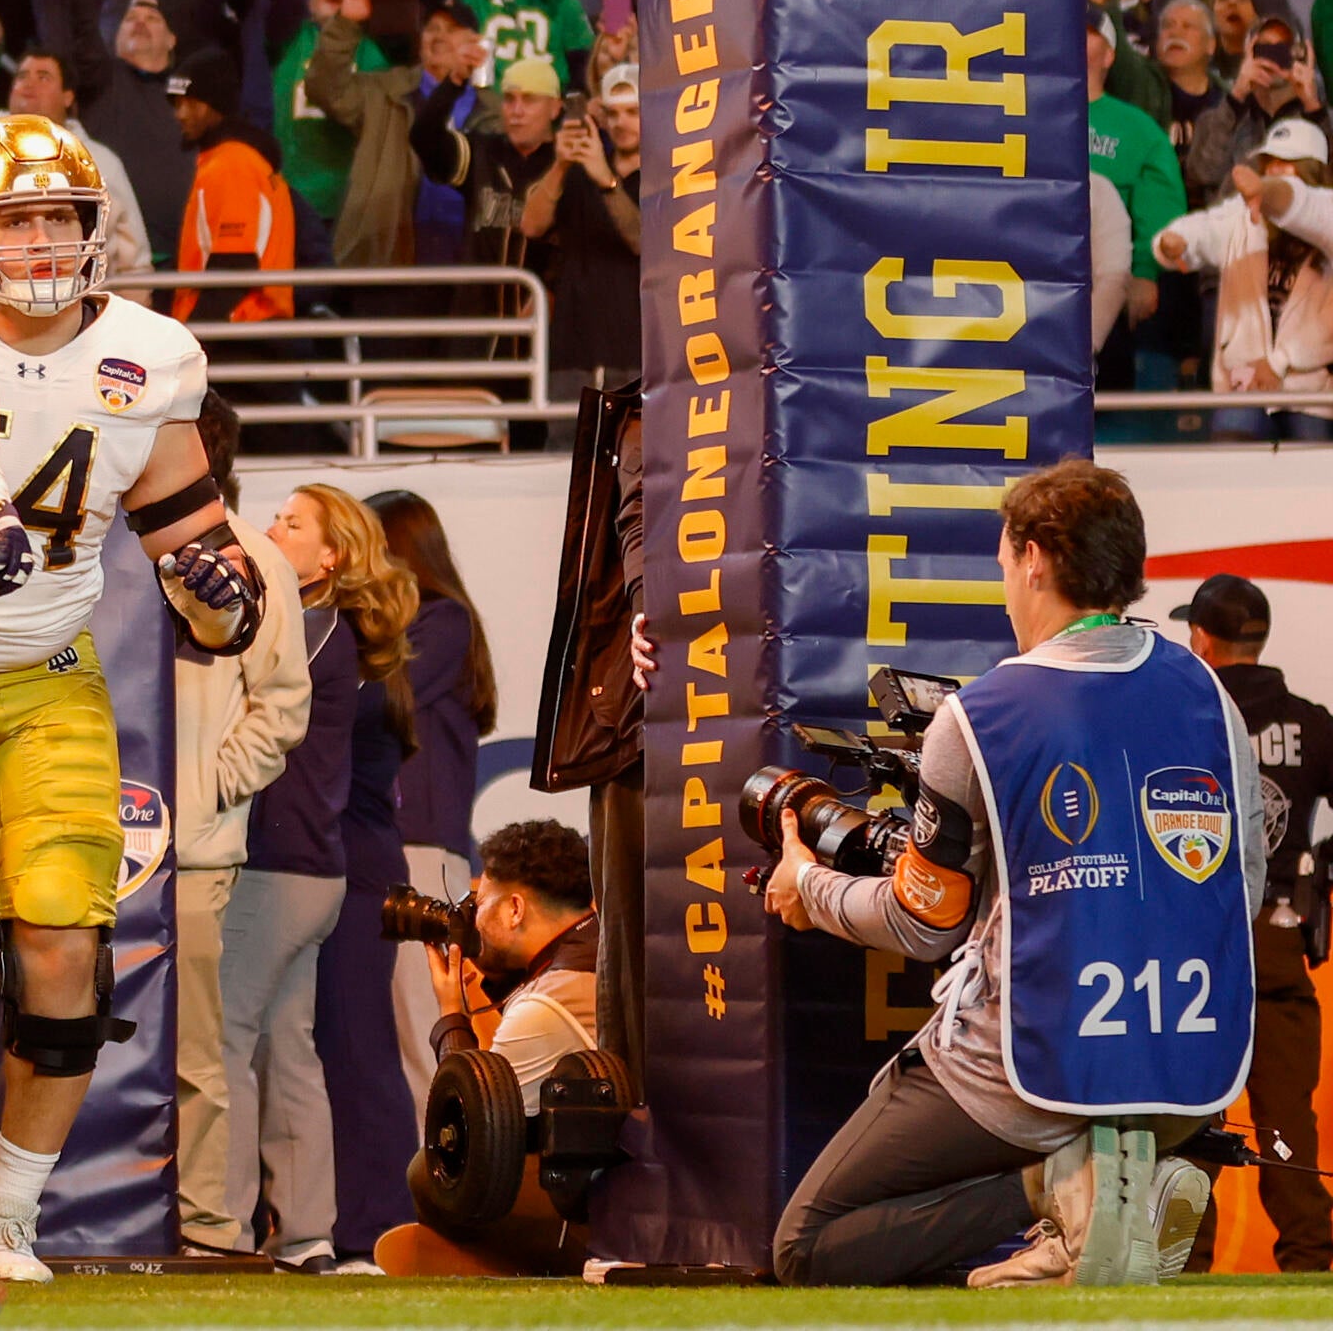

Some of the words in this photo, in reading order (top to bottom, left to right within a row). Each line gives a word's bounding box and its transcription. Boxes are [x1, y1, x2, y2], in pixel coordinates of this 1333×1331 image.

[1150, 788, 1223, 805] CapitalOne
[1154, 812, 1196, 834] ORANGE
[1197, 814, 1224, 837] BOWL
[1028, 856, 1072, 876] COLLEGE
[1073, 853, 1129, 867] FOOTBALL
[1028, 866, 1130, 896] PLAYOFF
[1077, 957, 1218, 1038] 212
